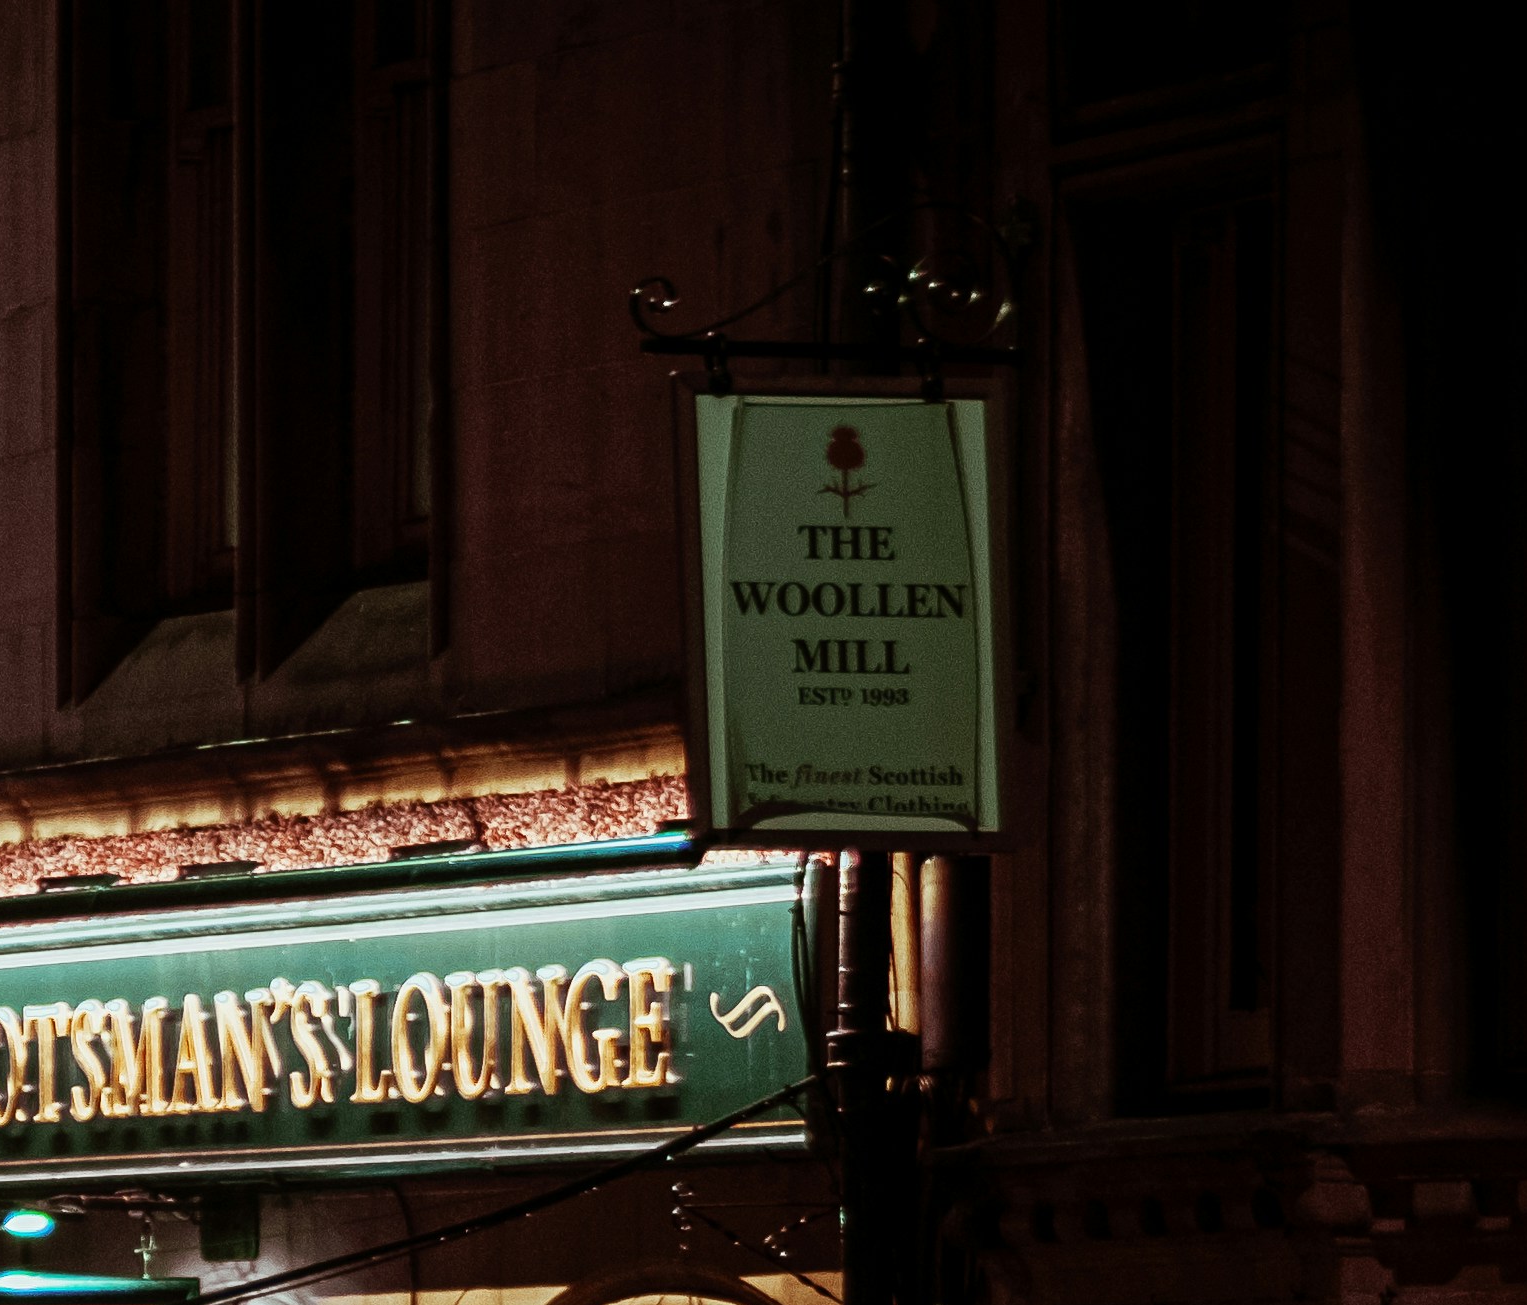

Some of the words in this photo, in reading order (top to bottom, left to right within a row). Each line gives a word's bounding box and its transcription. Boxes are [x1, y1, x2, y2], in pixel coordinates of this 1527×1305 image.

[798, 525, 896, 561] THE
[730, 581, 967, 618] WOOLLEN
[792, 639, 909, 675] MILL
[862, 687, 909, 707] 1993
[744, 763, 789, 784] The
[868, 765, 964, 786] Scottish
[350, 957, 678, 1103] LOUNGE
